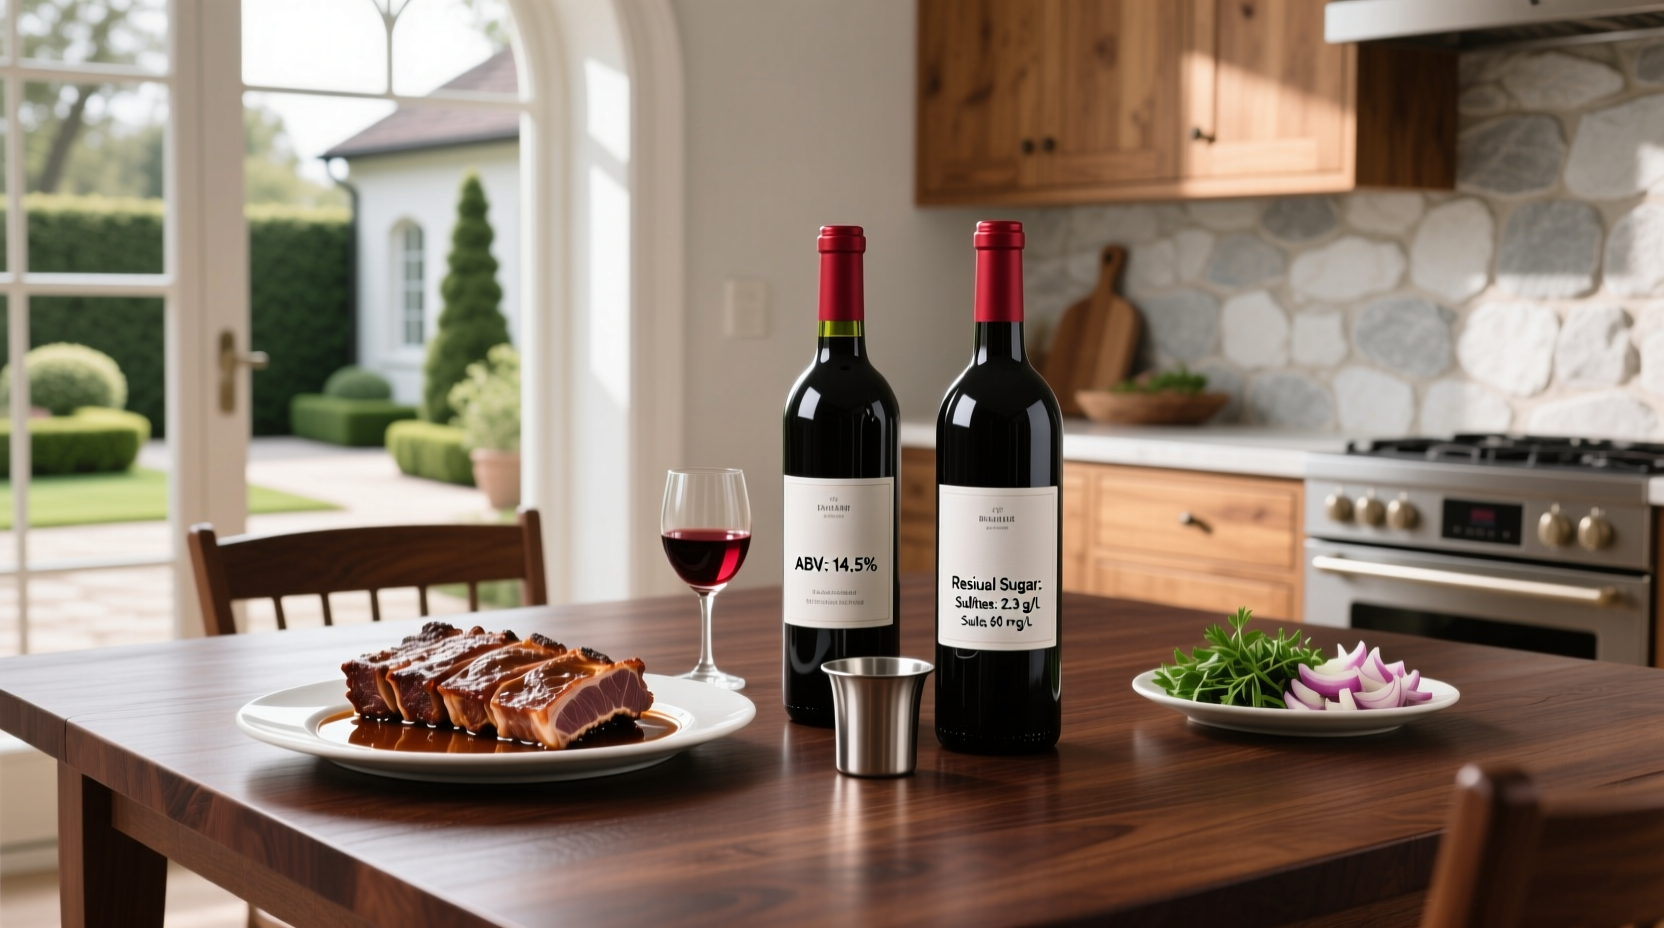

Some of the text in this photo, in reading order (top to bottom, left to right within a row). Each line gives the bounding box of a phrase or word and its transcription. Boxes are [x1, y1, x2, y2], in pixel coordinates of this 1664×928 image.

[833, 556, 878, 573] 14.5%
[1000, 577, 1042, 594] Sugar:
[1001, 598, 1020, 610] 2.3
